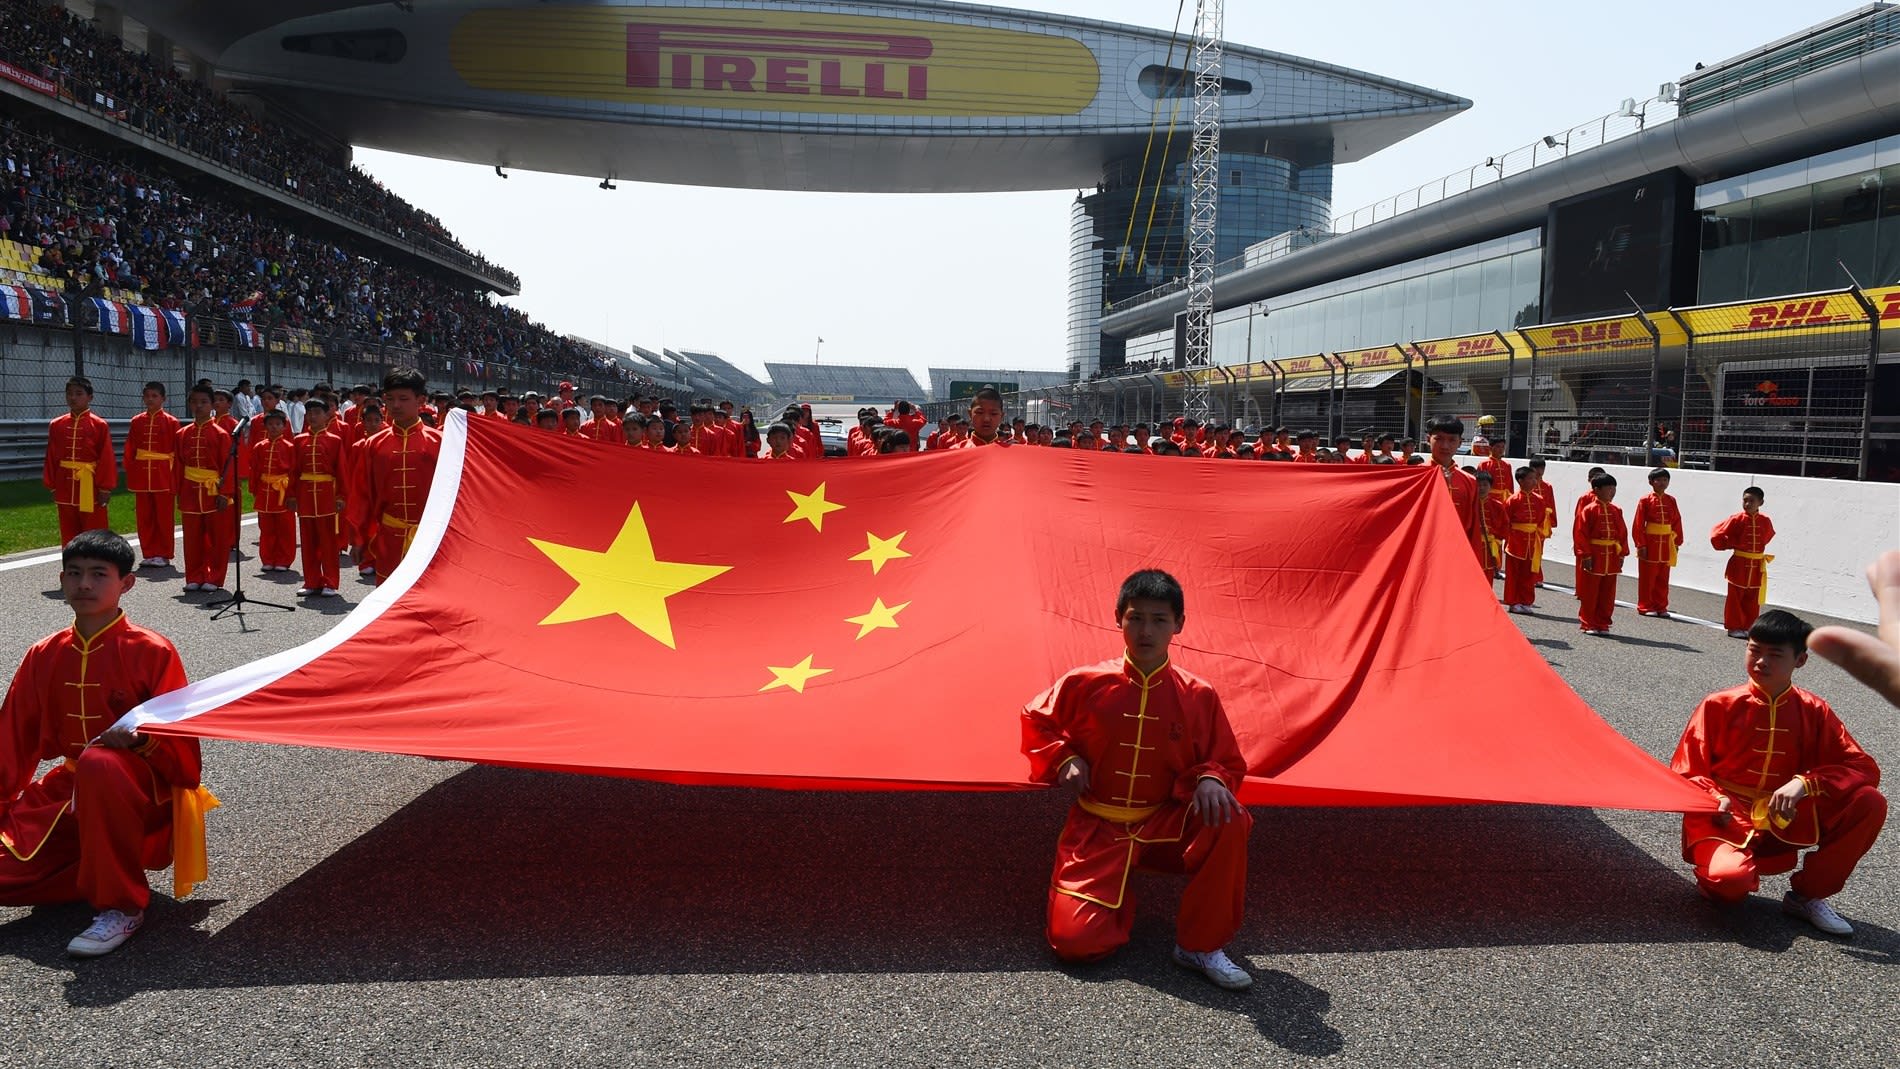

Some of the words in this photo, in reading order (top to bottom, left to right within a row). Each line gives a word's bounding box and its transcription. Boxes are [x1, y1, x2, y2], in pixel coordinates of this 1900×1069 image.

[626, 22, 933, 100] PIRELLI
[1748, 299, 1832, 330] DHL
[1457, 337, 1497, 356] DHL
[1550, 321, 1634, 353] DHL
[1290, 359, 1312, 373] DHL
[1361, 350, 1390, 367] DHL
[1743, 393, 1765, 406] Toro
[1768, 393, 1801, 406] Rosso
